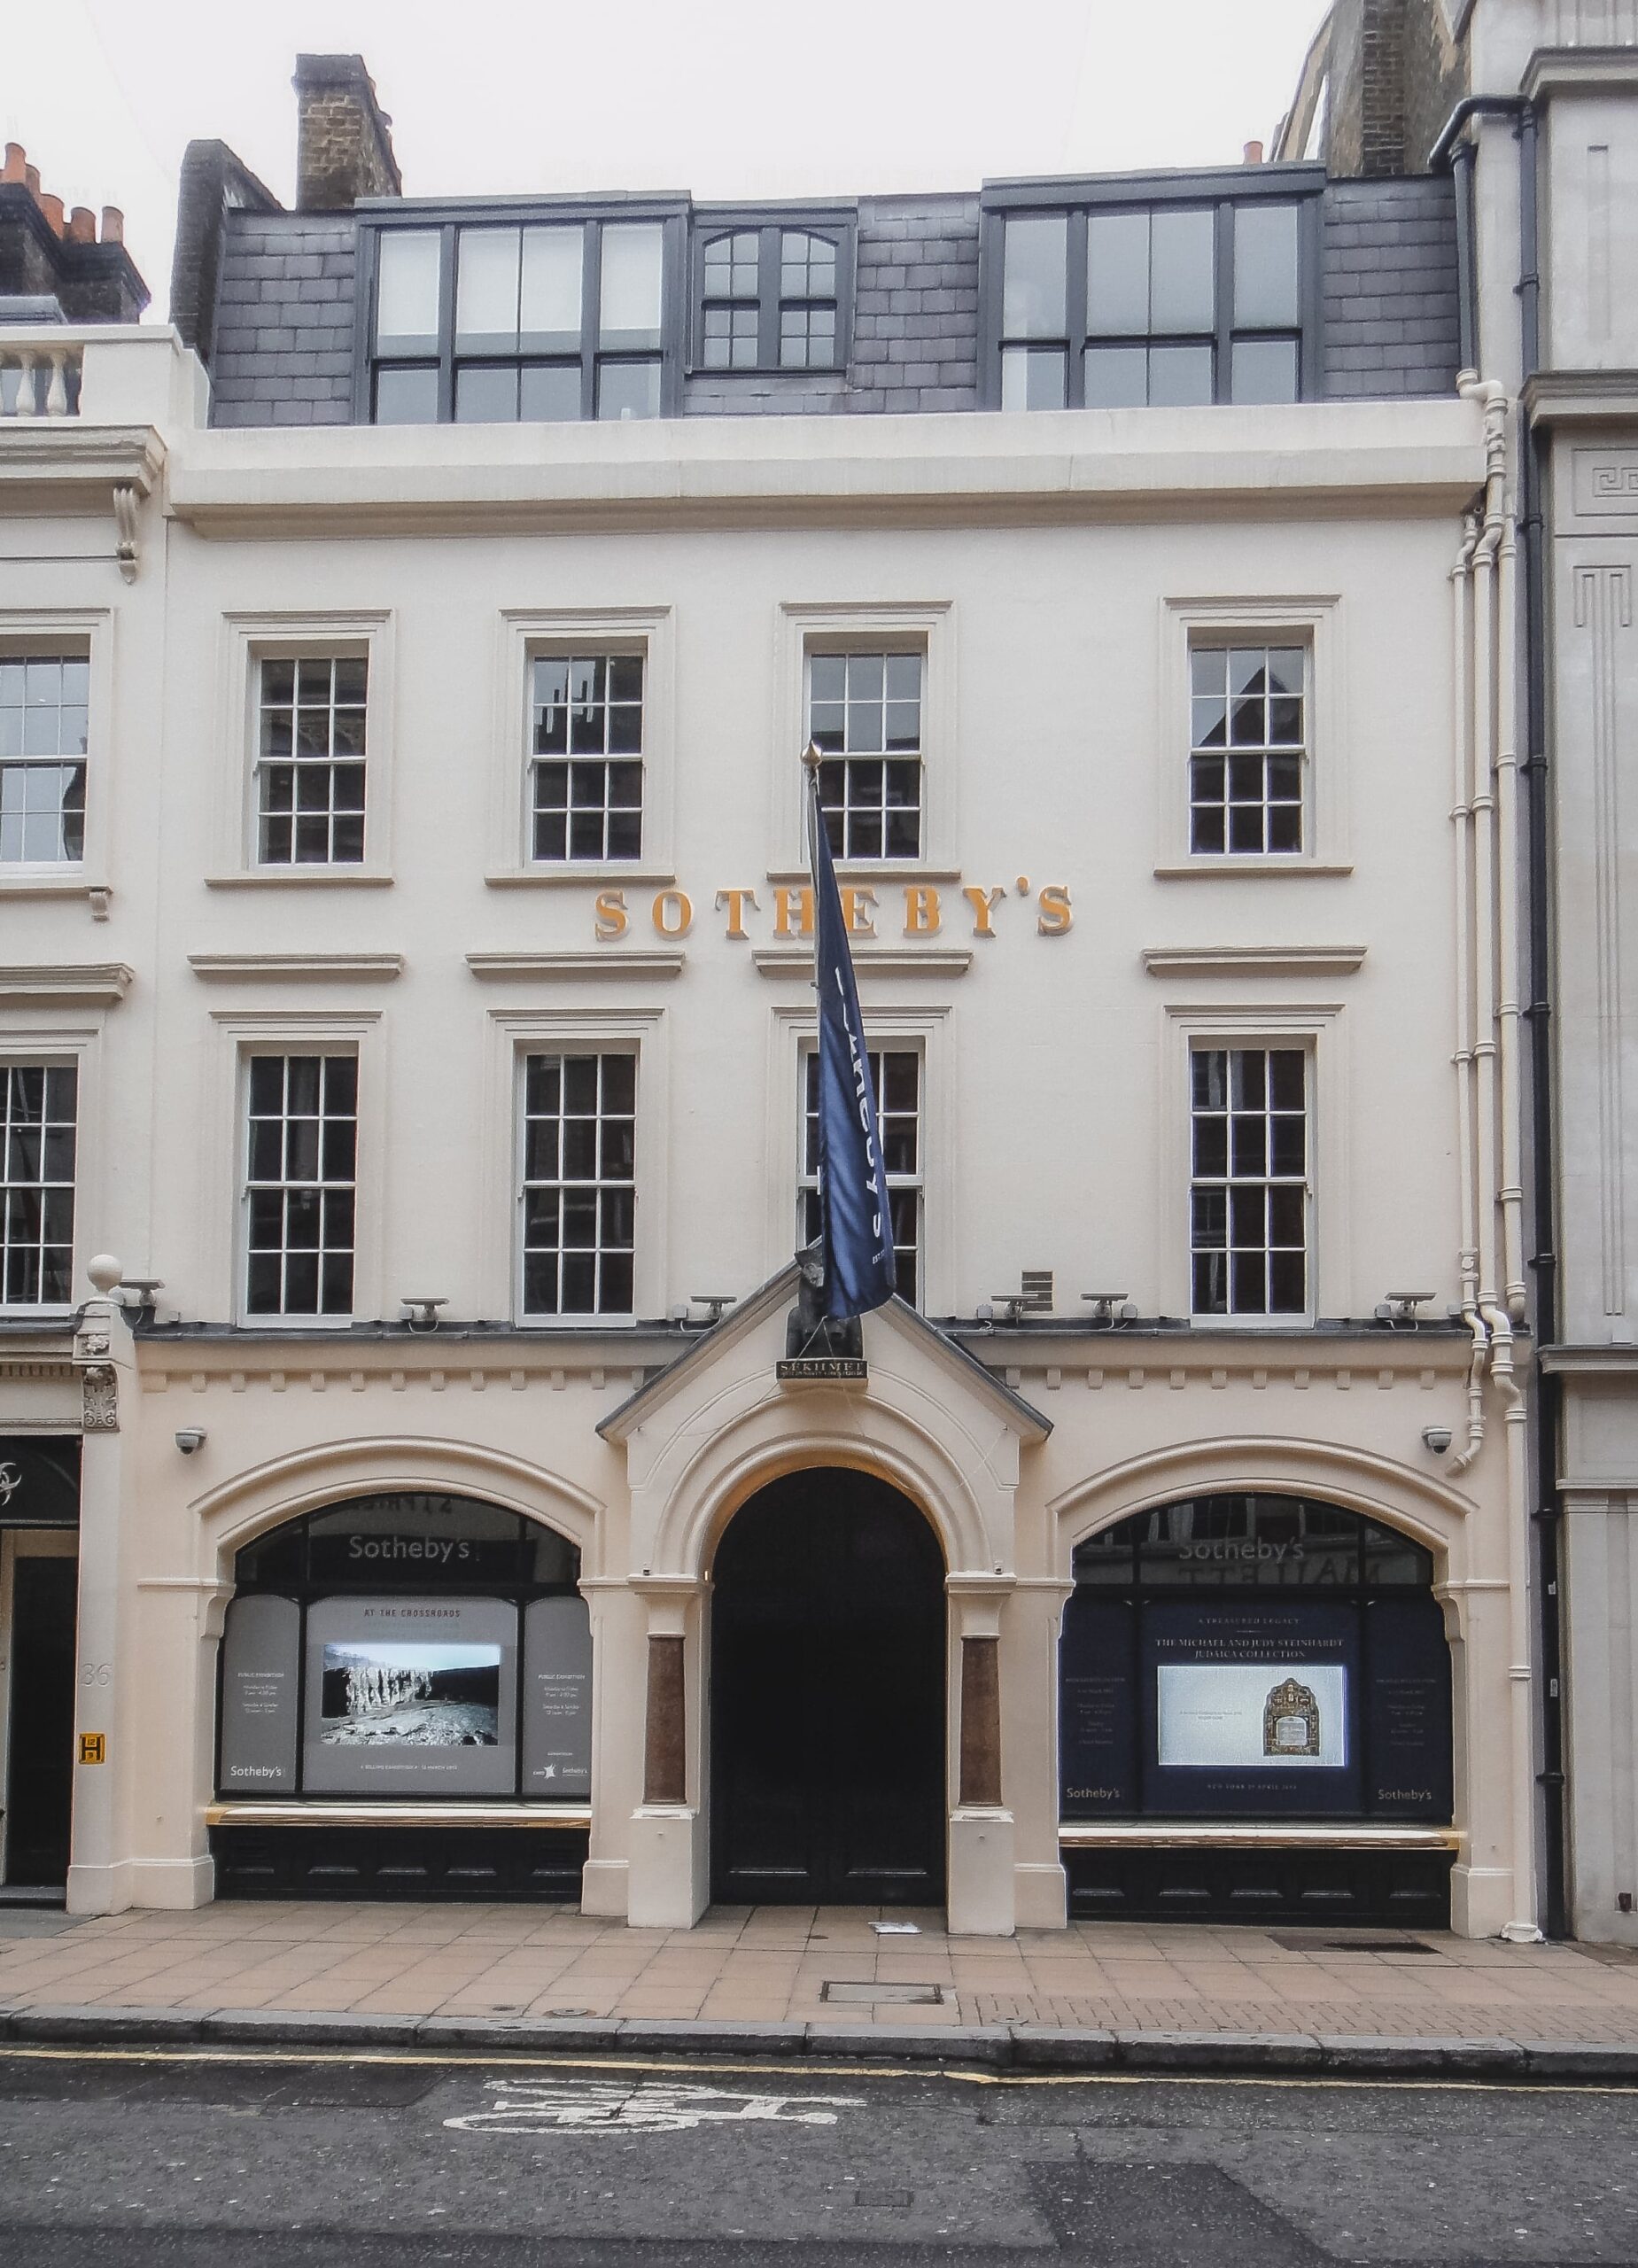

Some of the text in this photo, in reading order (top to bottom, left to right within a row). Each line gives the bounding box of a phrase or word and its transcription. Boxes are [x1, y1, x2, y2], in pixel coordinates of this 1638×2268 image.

[595, 875, 1074, 941] SOTHEBY'S
[349, 1535, 470, 1564] Sotheby's
[400, 1609, 461, 1618] CROSSROADS
[1178, 1639, 1224, 1648] MICHAEL
[1228, 1639, 1250, 1648] AND
[1251, 1639, 1276, 1649] JUDY
[1194, 1650, 1306, 1659] JUDAICA COLLECTION
[80, 1662, 111, 1687] 36
[230, 1765, 282, 1779] Sotheby's
[1067, 1787, 1121, 1800] Sotheby's
[1378, 1789, 1432, 1802] Sotheby's
